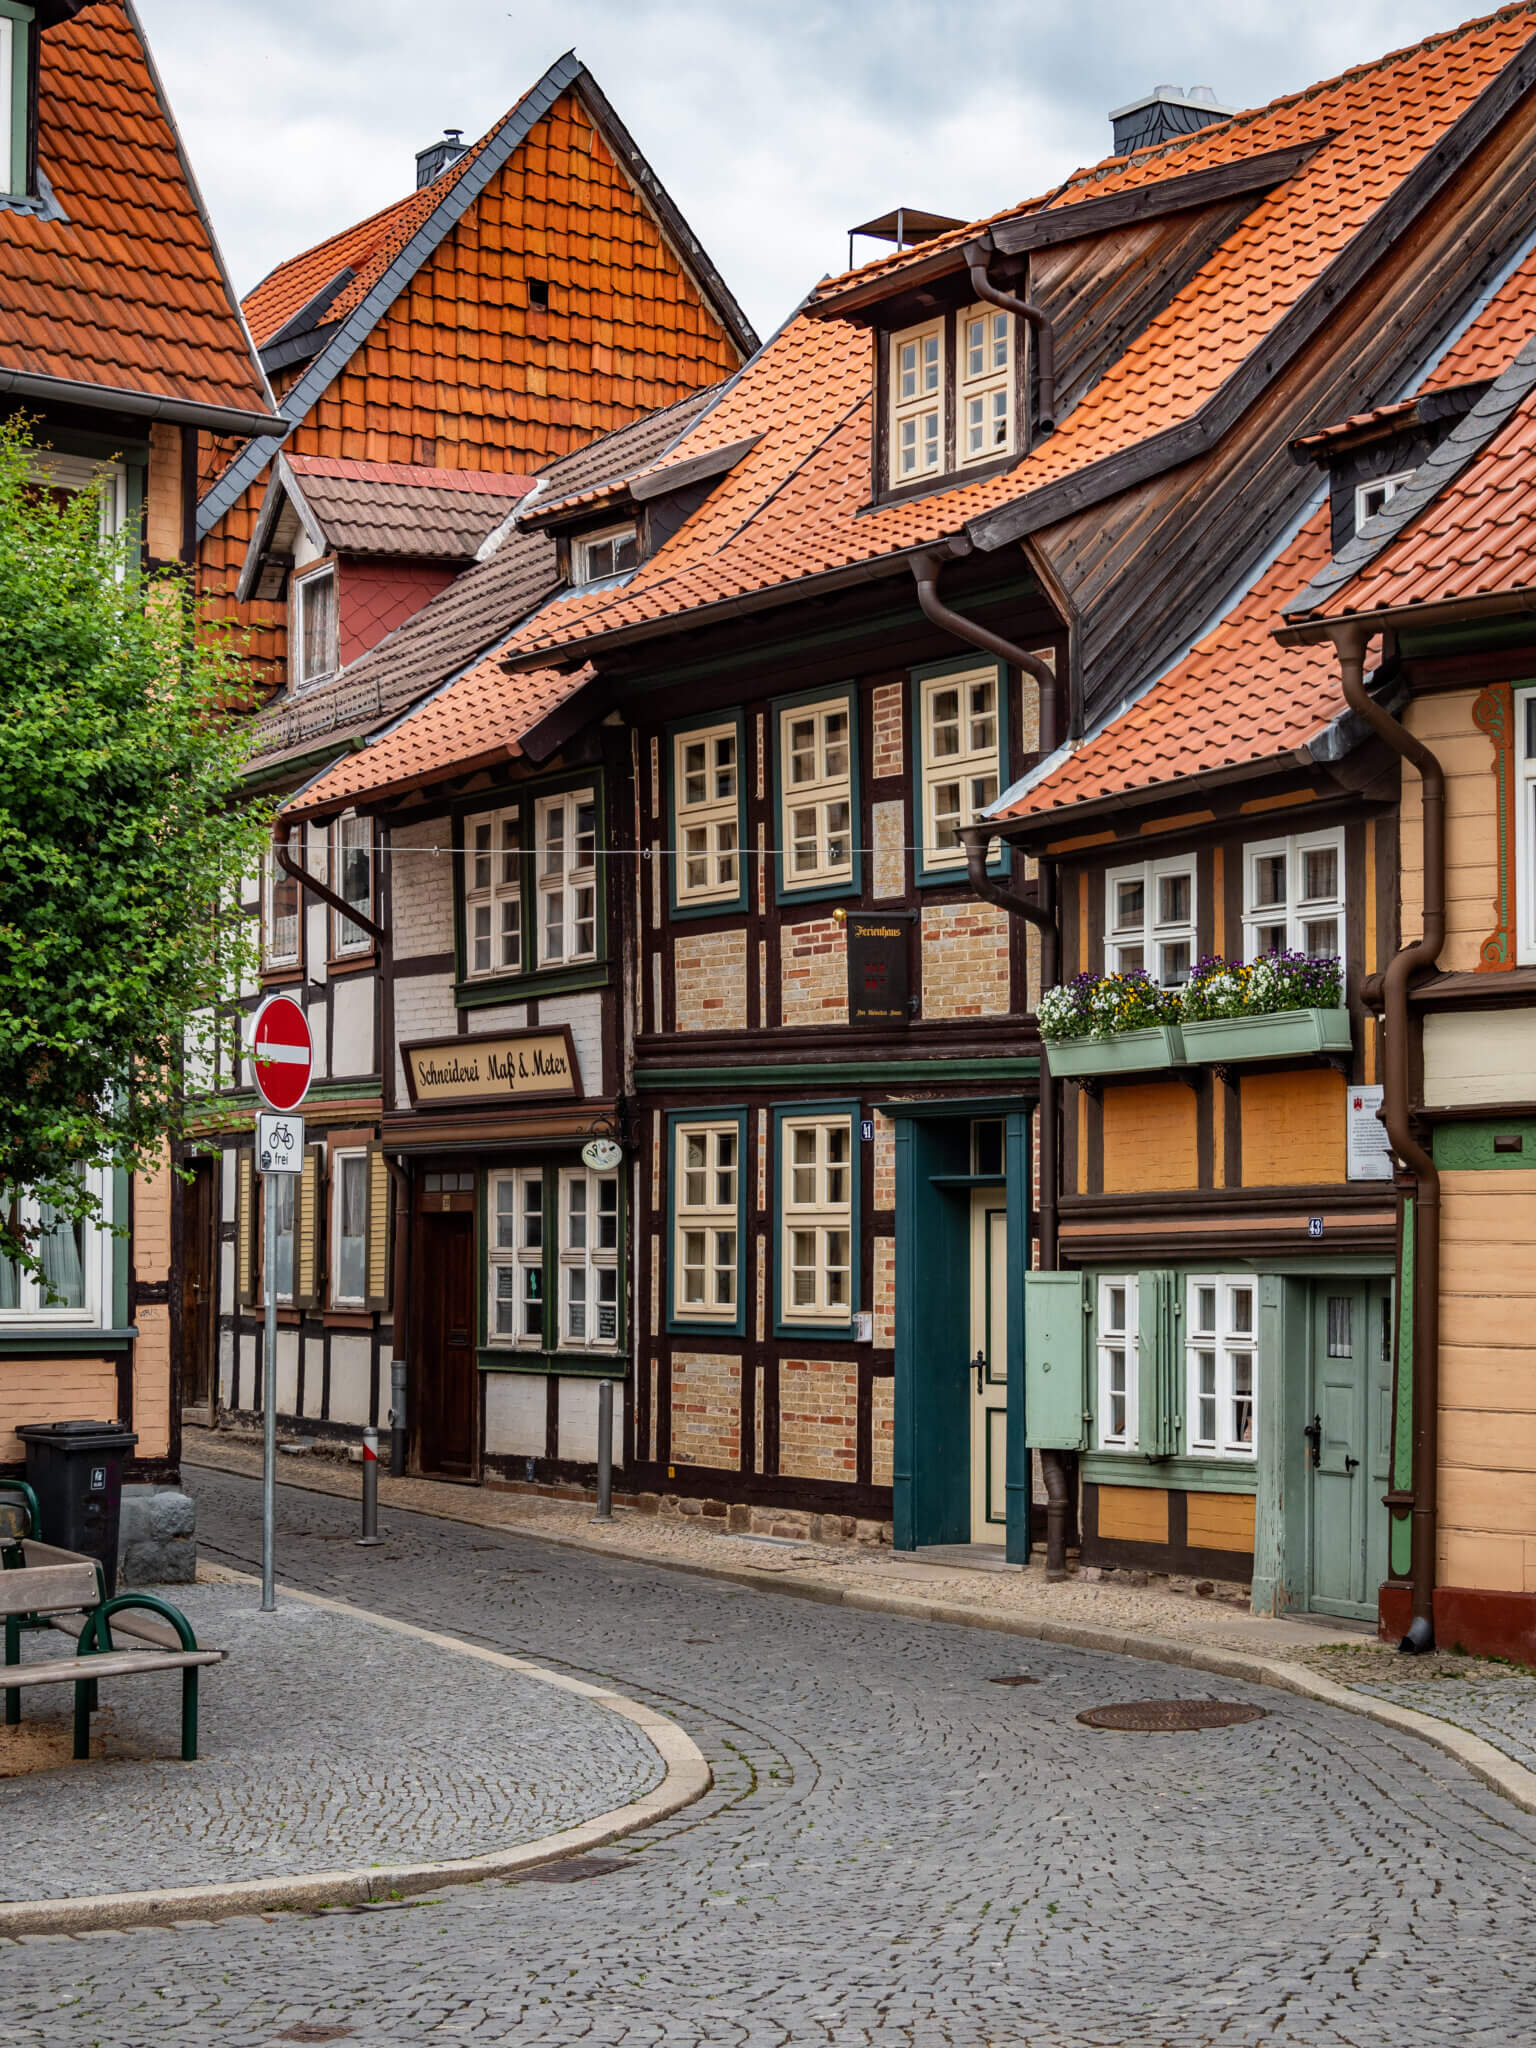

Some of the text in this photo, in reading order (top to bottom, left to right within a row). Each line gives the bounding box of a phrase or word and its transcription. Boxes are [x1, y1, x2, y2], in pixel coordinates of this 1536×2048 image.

[855, 924, 902, 938] Ferienhaus
[418, 1049, 567, 1089] Schneiderei Maß & Meter
[863, 1123, 871, 1139] 41
[275, 1152, 289, 1165] frei
[1310, 1219, 1321, 1235] 43
